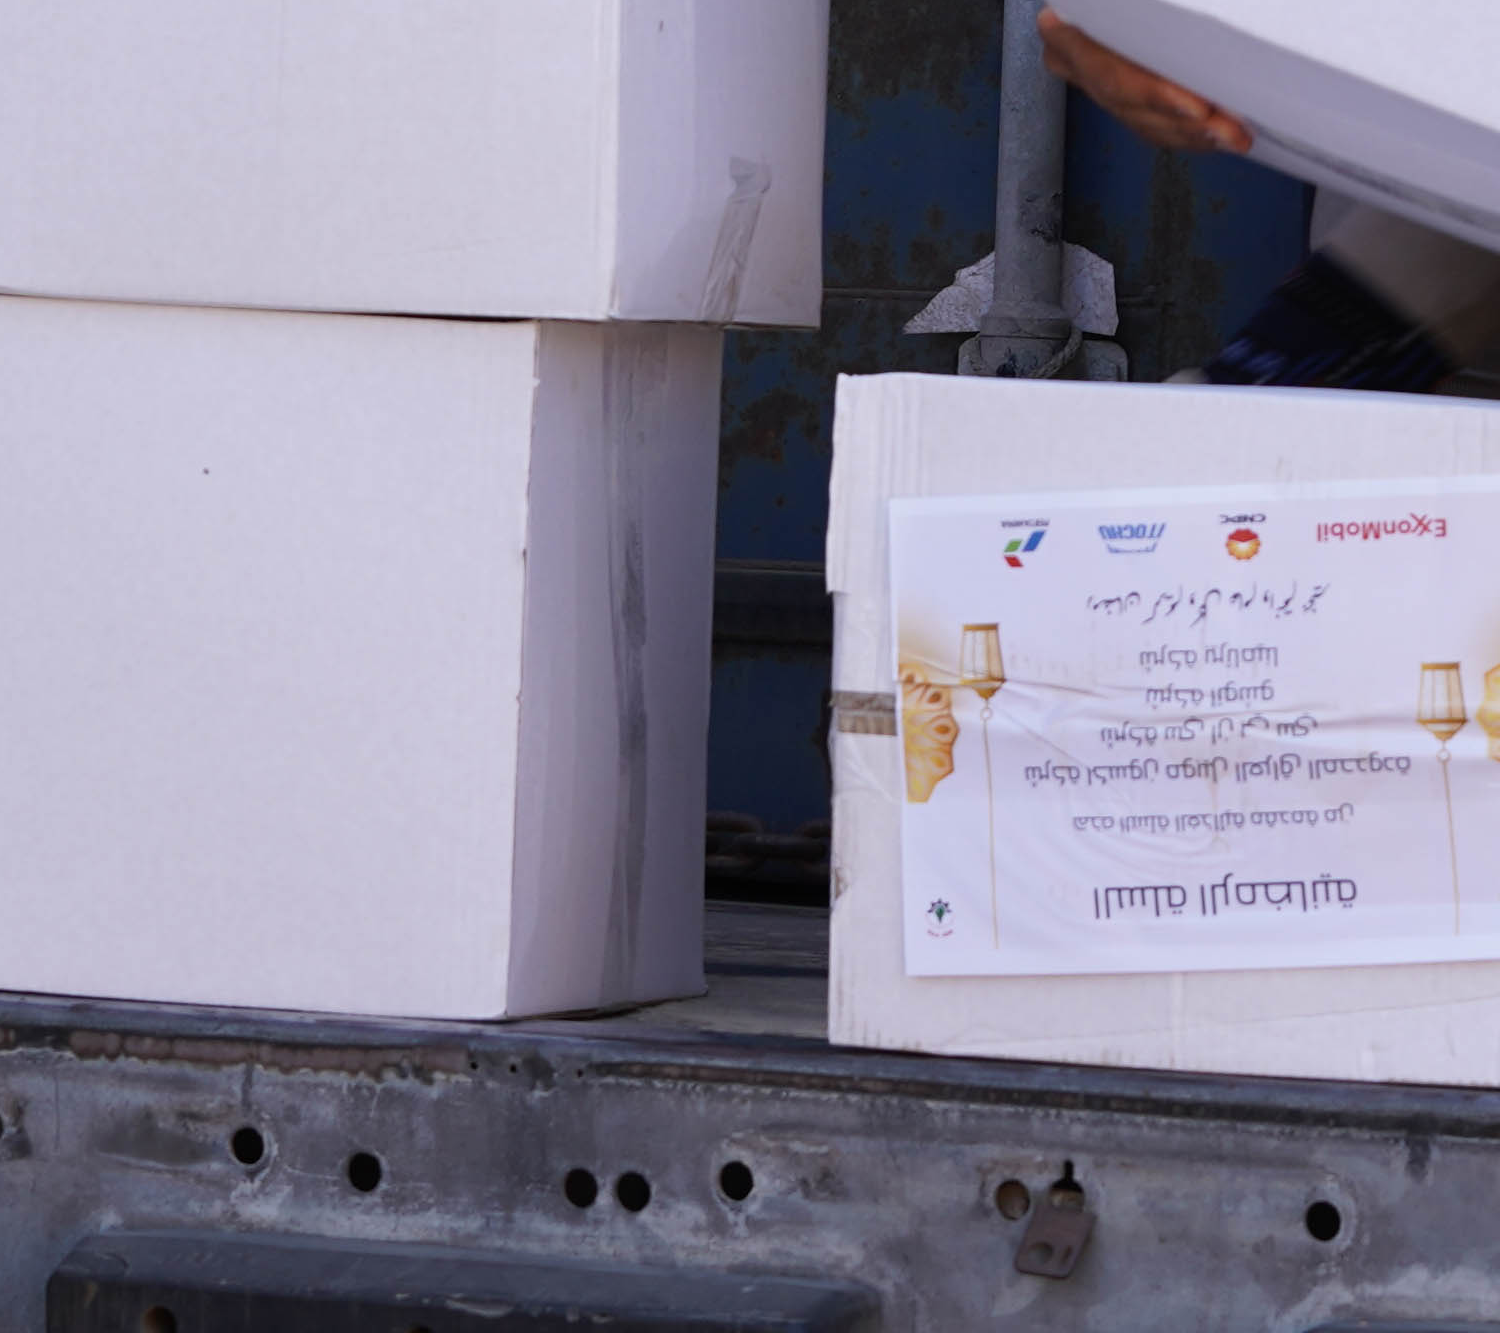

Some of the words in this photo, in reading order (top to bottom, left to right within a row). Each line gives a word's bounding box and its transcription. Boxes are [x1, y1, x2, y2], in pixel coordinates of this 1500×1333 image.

[1317, 513, 1446, 543] ExxonMobil
[1139, 645, 1197, 672] شركة
[1145, 682, 1204, 709] شركة
[1100, 720, 1157, 745] شركة
[1024, 761, 1080, 788] شركة
[1309, 752, 1411, 780] المحدودة
[1250, 809, 1318, 829] مقدمة
[1324, 803, 1354, 827] من
[1093, 885, 1187, 919] السلة
[1200, 873, 1357, 916] الرمضانية
